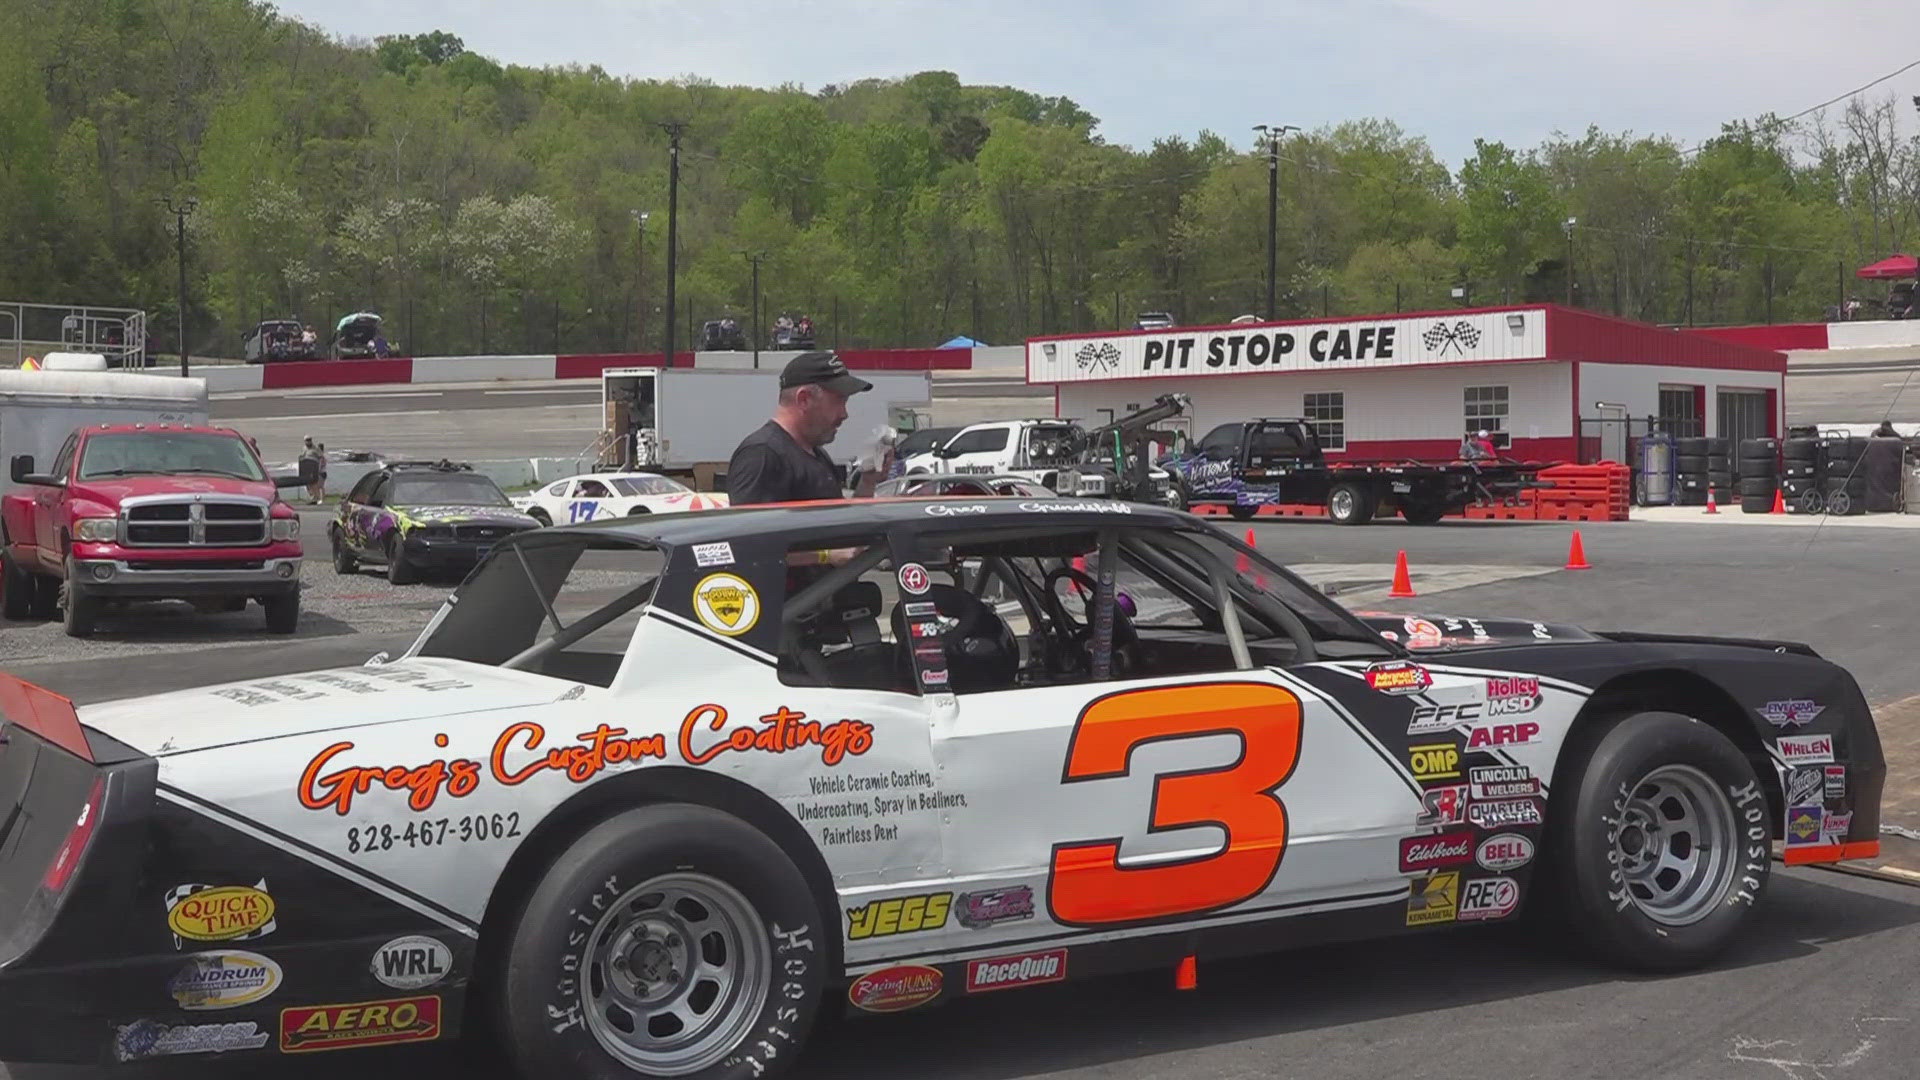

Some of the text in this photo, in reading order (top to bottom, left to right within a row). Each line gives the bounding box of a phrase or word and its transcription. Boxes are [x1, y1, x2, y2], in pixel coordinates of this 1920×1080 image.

[1143, 326, 1396, 370] PIT STOP CAFE
[568, 501, 599, 523] 17
[1487, 676, 1539, 698] Holley
[1411, 703, 1483, 724] PFC
[1488, 697, 1536, 717] MSD
[1468, 722, 1540, 748] ARP
[1780, 738, 1831, 757] WHELEN
[299, 703, 875, 815] Greg's Custom Coatings
[1410, 750, 1459, 774] OMP
[809, 769, 935, 795] Vehicle Ceramic Coating,
[1473, 767, 1528, 783] LINCOLN
[1486, 783, 1535, 796] WELDERS
[797, 800, 872, 821] Undercoating,
[874, 796, 904, 816] Spray
[919, 790, 968, 810] Bedliners,
[1046, 680, 1304, 929] 3
[1470, 800, 1533, 820] QUARTER
[347, 811, 522, 854] 828-467-3062
[822, 823, 898, 846] Paintless Dent
[1729, 779, 1766, 907] Hoosier
[1406, 839, 1469, 863] Edelbrock
[1485, 842, 1526, 860] BELL
[181, 894, 259, 919] QUICK
[848, 891, 953, 940] JEGS
[202, 910, 260, 933] TIME
[382, 947, 443, 977] WRL
[974, 955, 1060, 985] RaceQuip
[745, 923, 815, 1078] Hoosier
[297, 1002, 418, 1033] AERO
